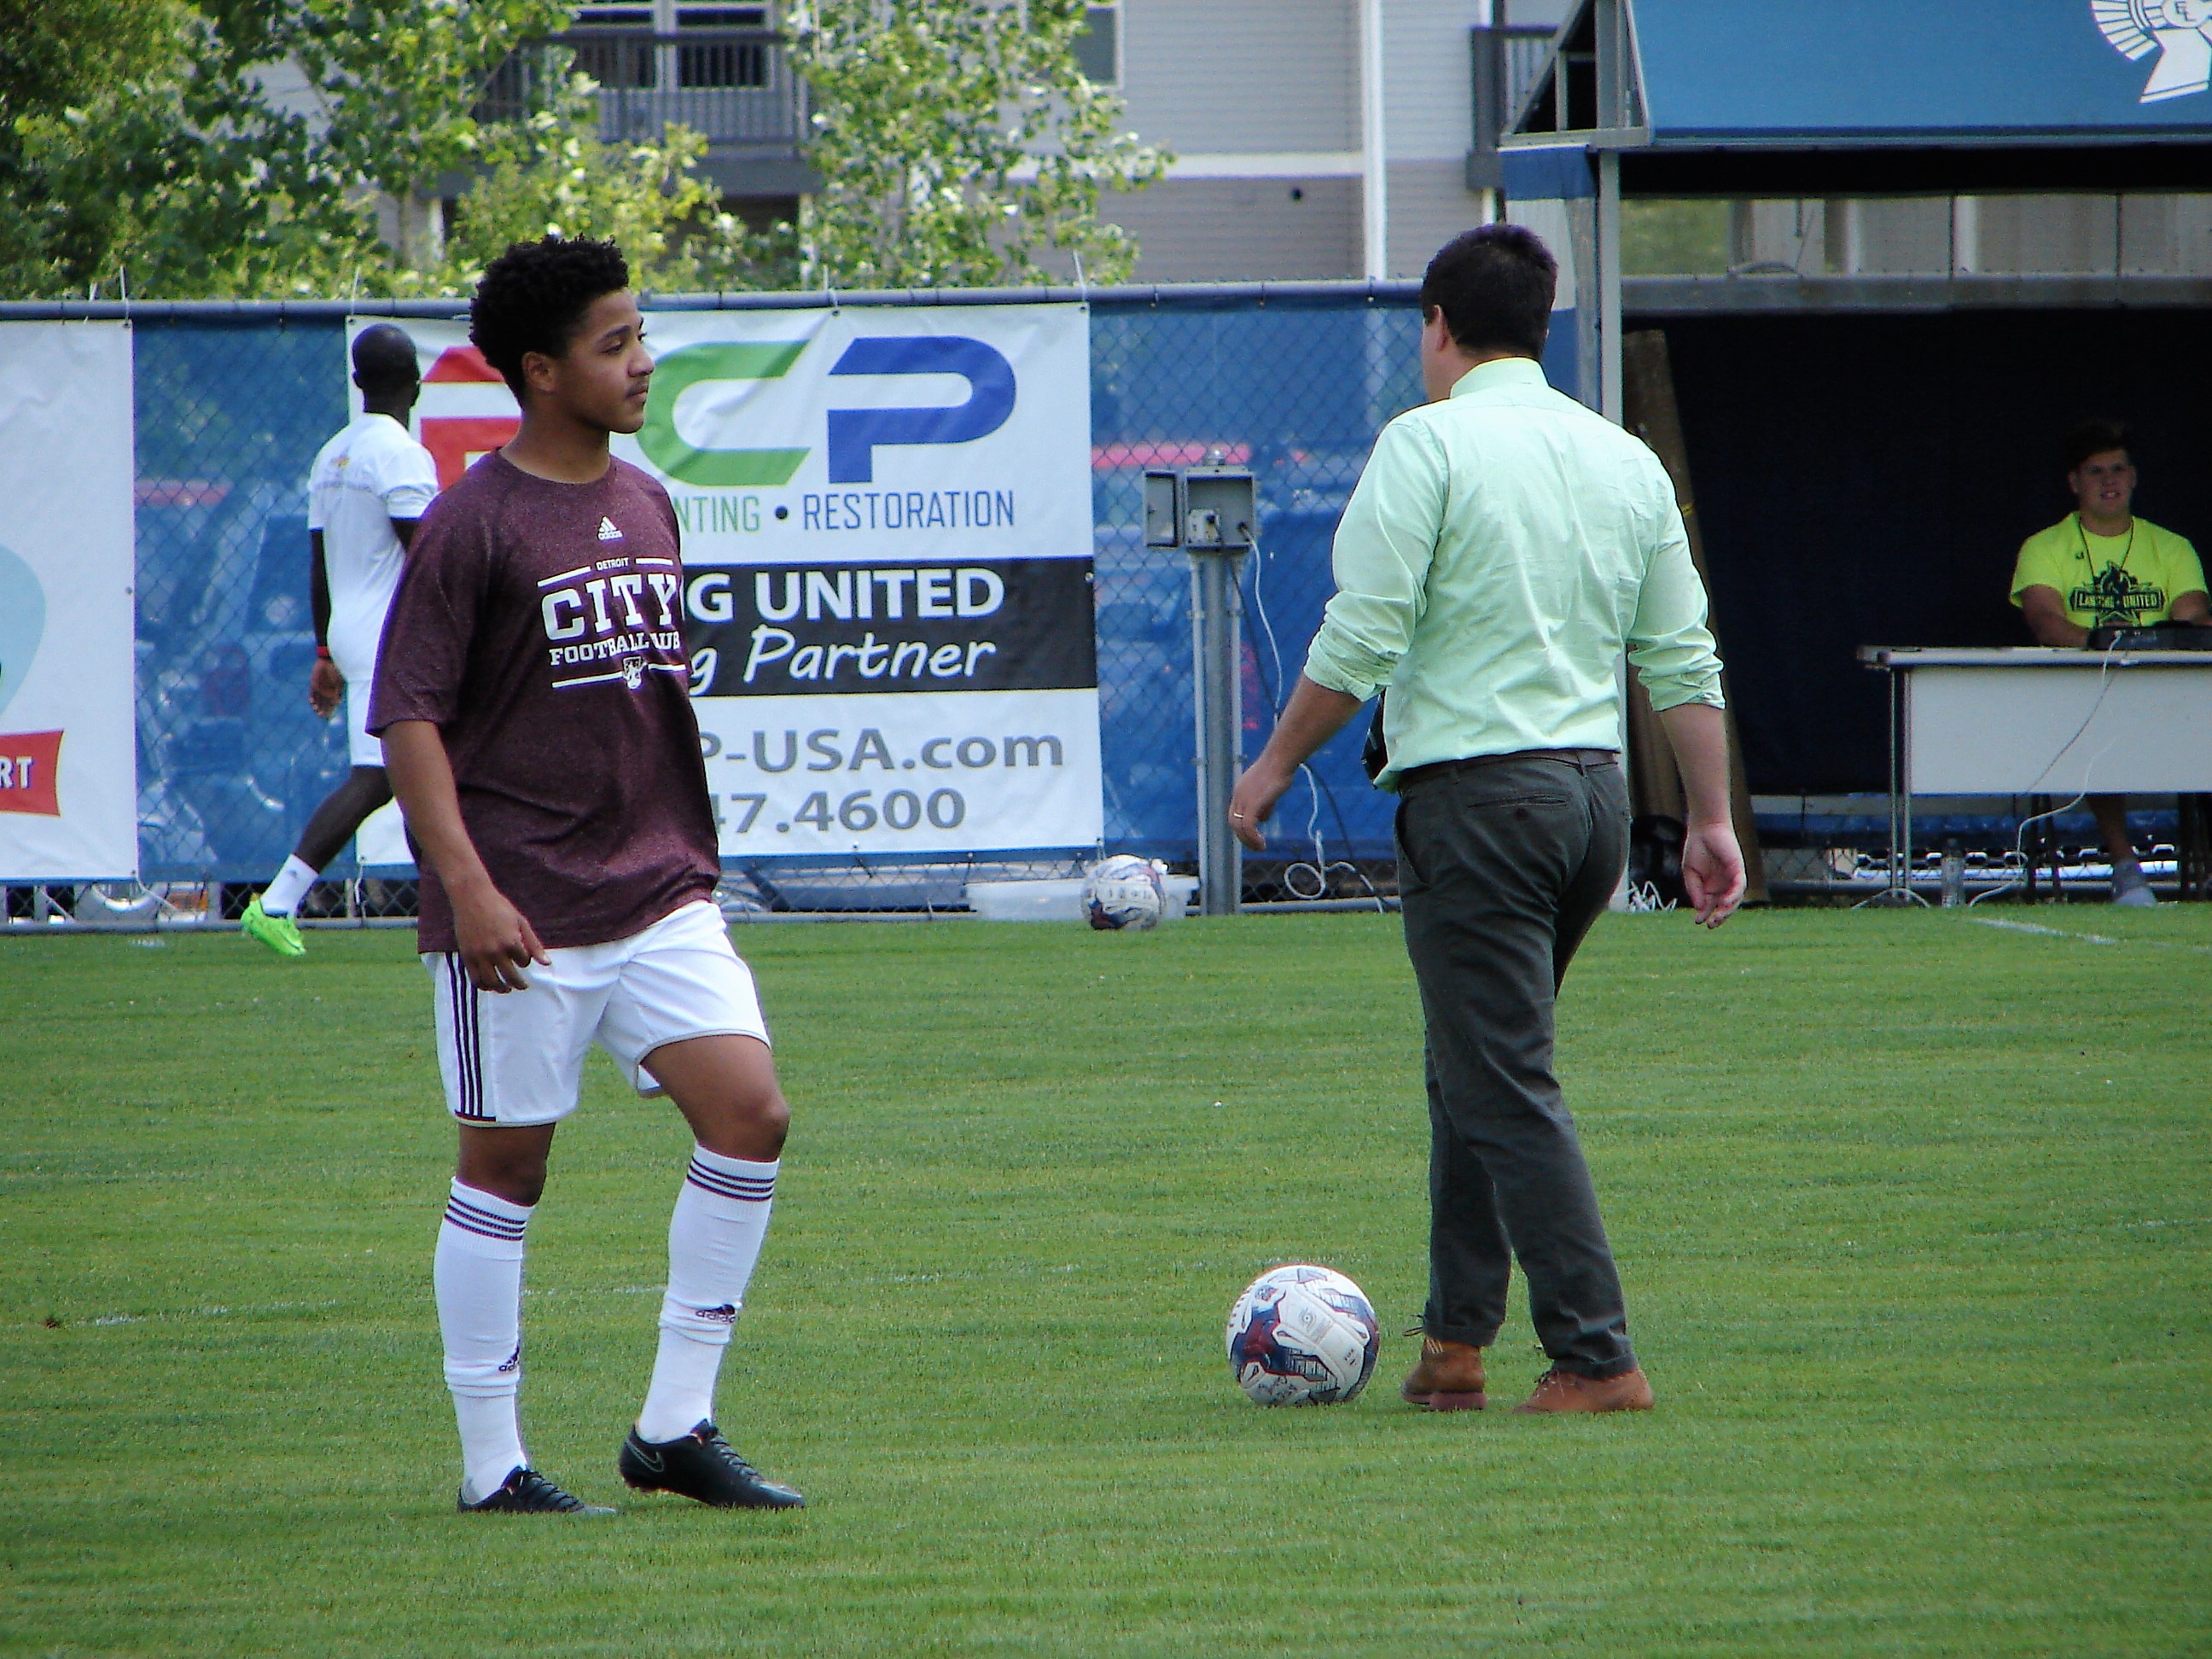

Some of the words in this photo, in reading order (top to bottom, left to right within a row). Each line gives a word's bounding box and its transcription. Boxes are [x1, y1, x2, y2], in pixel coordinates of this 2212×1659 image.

[803, 490, 1014, 530] RESTORATION
[596, 556, 629, 571] DETROIT
[542, 573, 677, 640] CITY
[680, 572, 735, 623] G
[754, 567, 1005, 622] UNITED
[549, 632, 649, 666] FOOTBALL
[743, 623, 997, 684] Partner
